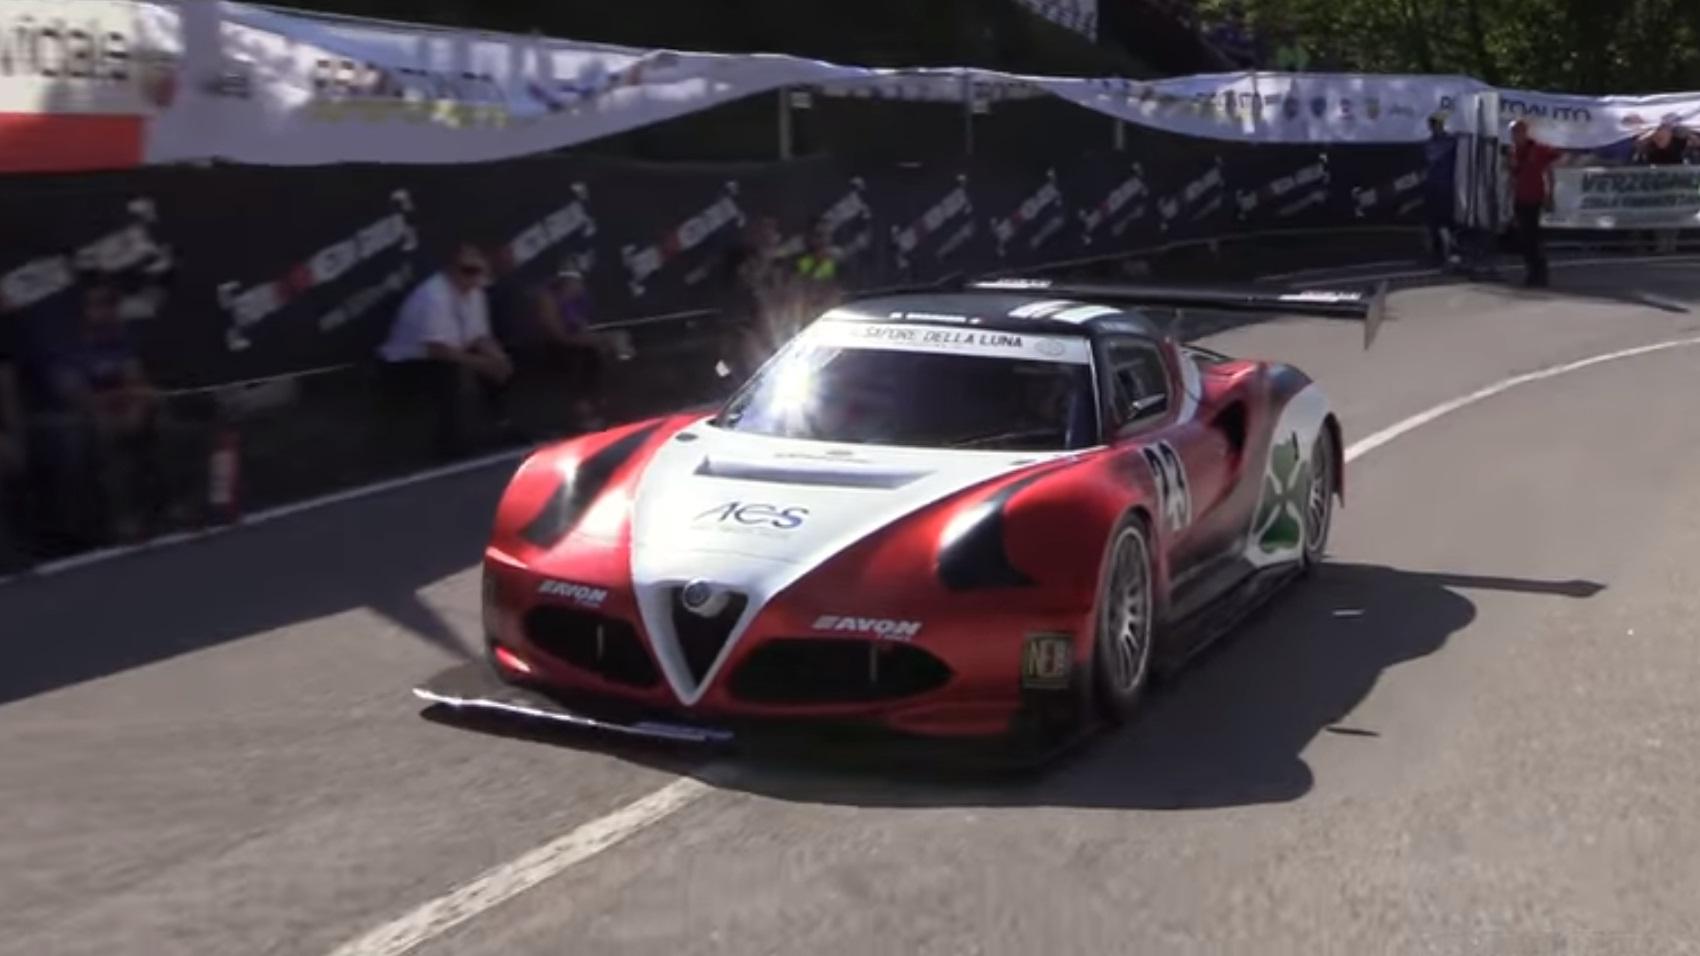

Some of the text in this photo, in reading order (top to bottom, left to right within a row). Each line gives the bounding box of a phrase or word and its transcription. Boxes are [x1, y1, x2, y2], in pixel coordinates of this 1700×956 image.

[923, 331, 974, 344] DELLA
[979, 334, 1023, 349] LUNA
[833, 617, 923, 636] AVON
